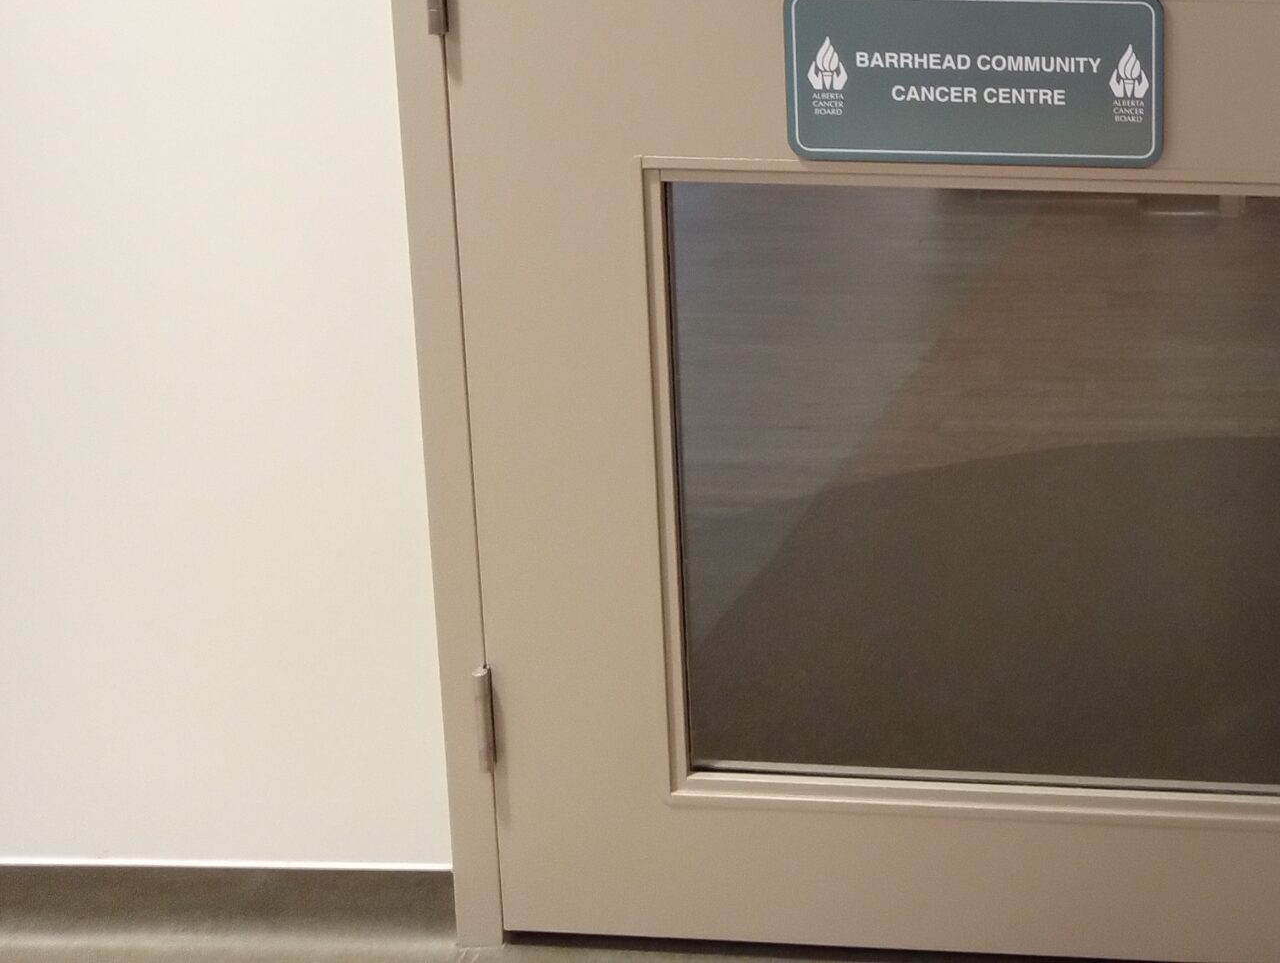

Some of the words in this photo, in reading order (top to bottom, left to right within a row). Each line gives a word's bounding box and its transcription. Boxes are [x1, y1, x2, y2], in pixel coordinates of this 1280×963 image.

[856, 51, 971, 71] BARRHEAD
[977, 54, 1102, 74] COMMUNITY
[812, 92, 845, 101] ALBERTA
[891, 85, 978, 103] CANCER
[983, 88, 1067, 106] CENTRE
[812, 100, 844, 109] CANCER
[1112, 99, 1145, 108] ALBERTA
[814, 108, 843, 116] BOARD
[1112, 107, 1144, 116] CANCER
[1114, 115, 1144, 123] BOARD
